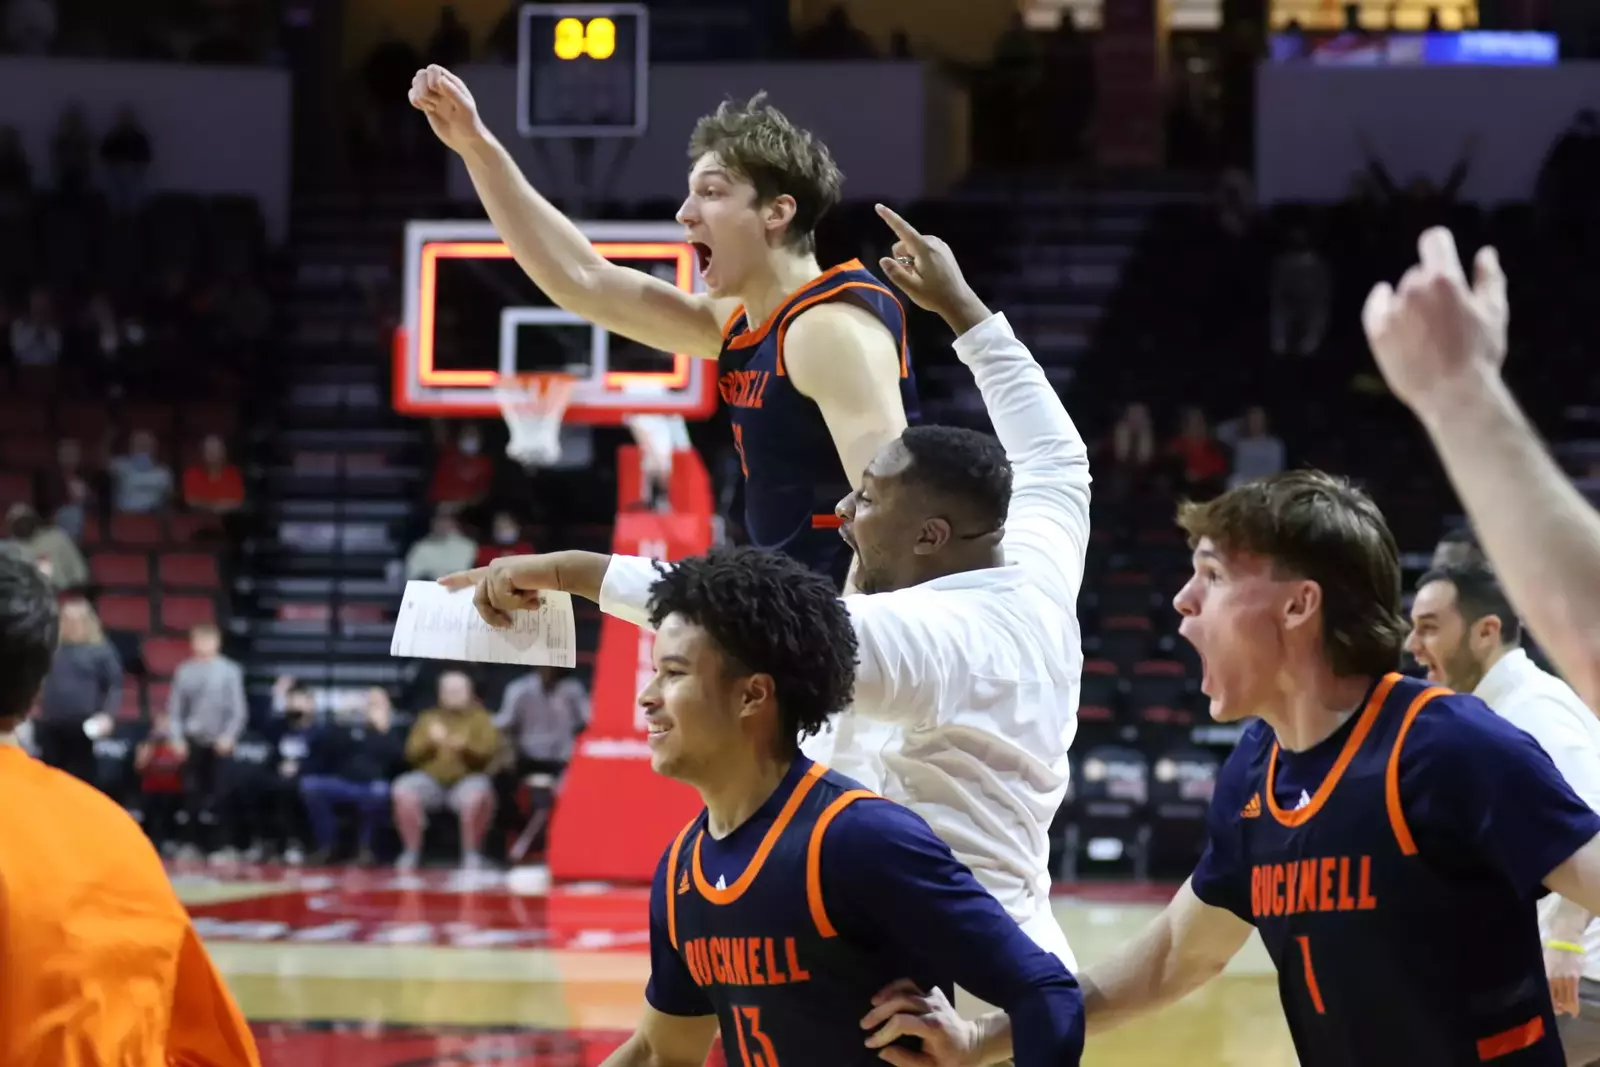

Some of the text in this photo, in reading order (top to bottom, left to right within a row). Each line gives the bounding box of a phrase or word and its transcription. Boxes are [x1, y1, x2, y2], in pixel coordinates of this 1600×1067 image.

[1251, 855, 1377, 917] BUCKNELL
[685, 936, 811, 986] BUCKNELL
[1296, 935, 1326, 1014] 1
[731, 1005, 781, 1067] 13
